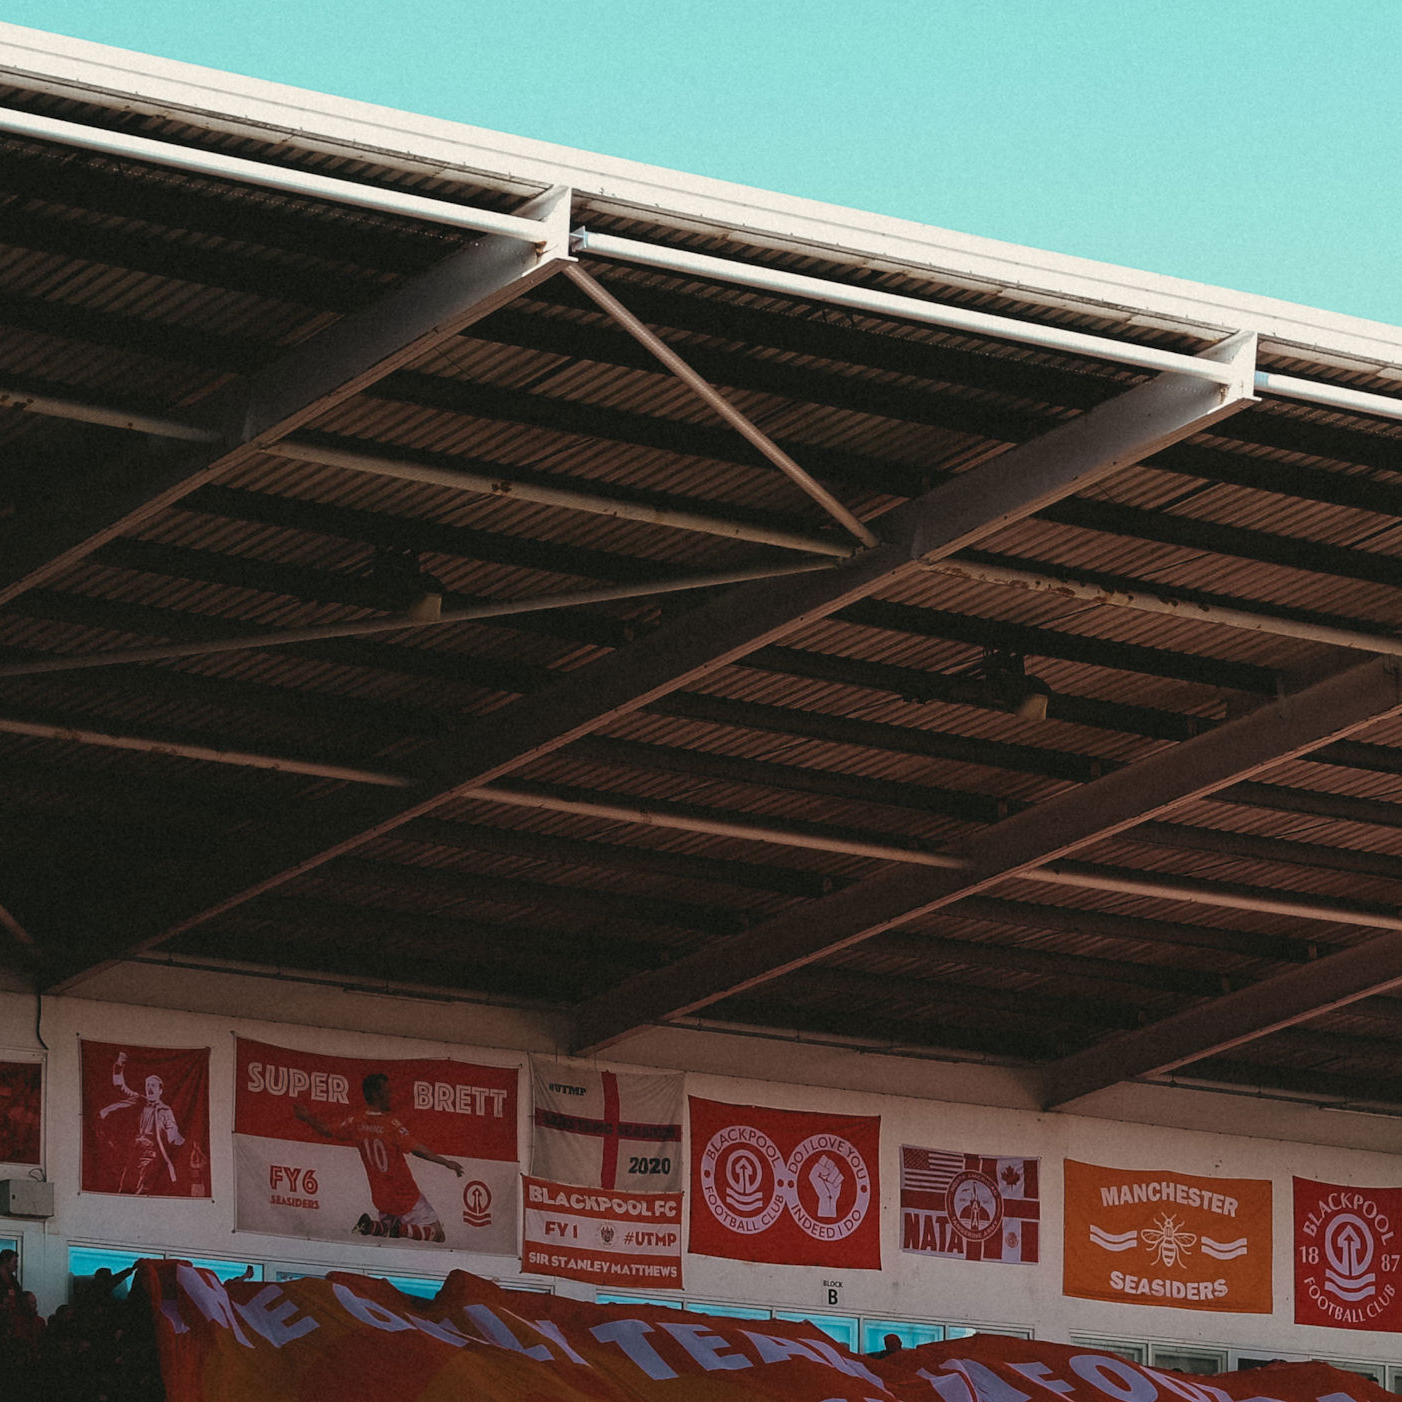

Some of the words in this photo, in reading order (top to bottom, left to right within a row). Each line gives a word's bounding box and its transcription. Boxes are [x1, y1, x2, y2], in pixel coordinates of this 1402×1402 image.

[247, 1061, 349, 1105] SUPER
[413, 1080, 507, 1118] BRETT
[549, 1083, 587, 1096] #UTMP
[364, 1137, 389, 1173] 10
[706, 1128, 781, 1168] BLACKPOOL
[788, 1151, 805, 1175] DO
[810, 1136, 846, 1152] LOVE
[847, 1146, 867, 1180] YOU
[269, 1164, 319, 1195] FY6
[628, 1157, 671, 1175] 2020
[270, 1195, 320, 1210] SEASIDERS
[528, 1184, 652, 1216] BLACKPOOL
[654, 1200, 677, 1217] FC
[704, 1185, 759, 1232] FOOTBALL
[761, 1194, 784, 1225] CLUB
[1100, 1182, 1239, 1218] MANCHESTER
[545, 1221, 569, 1237] FY
[791, 1203, 835, 1239] INDEED
[847, 1209, 862, 1230] DO
[903, 1212, 964, 1254] NATA
[1303, 1192, 1395, 1246] BLACKPOOL
[624, 1232, 677, 1247] #UTMP
[528, 1252, 549, 1265] SIR
[551, 1256, 610, 1273] STANLEY
[611, 1264, 678, 1278] MATTHEWS
[1299, 1245, 1319, 1264] 18
[1381, 1254, 1400, 1272] 87
[823, 1280, 843, 1288] BLOCK
[828, 1289, 838, 1305] B
[1110, 1270, 1229, 1300] SEASIDERS
[1304, 1276, 1366, 1323] FOOTBALL
[1366, 1284, 1396, 1318] CLUB
